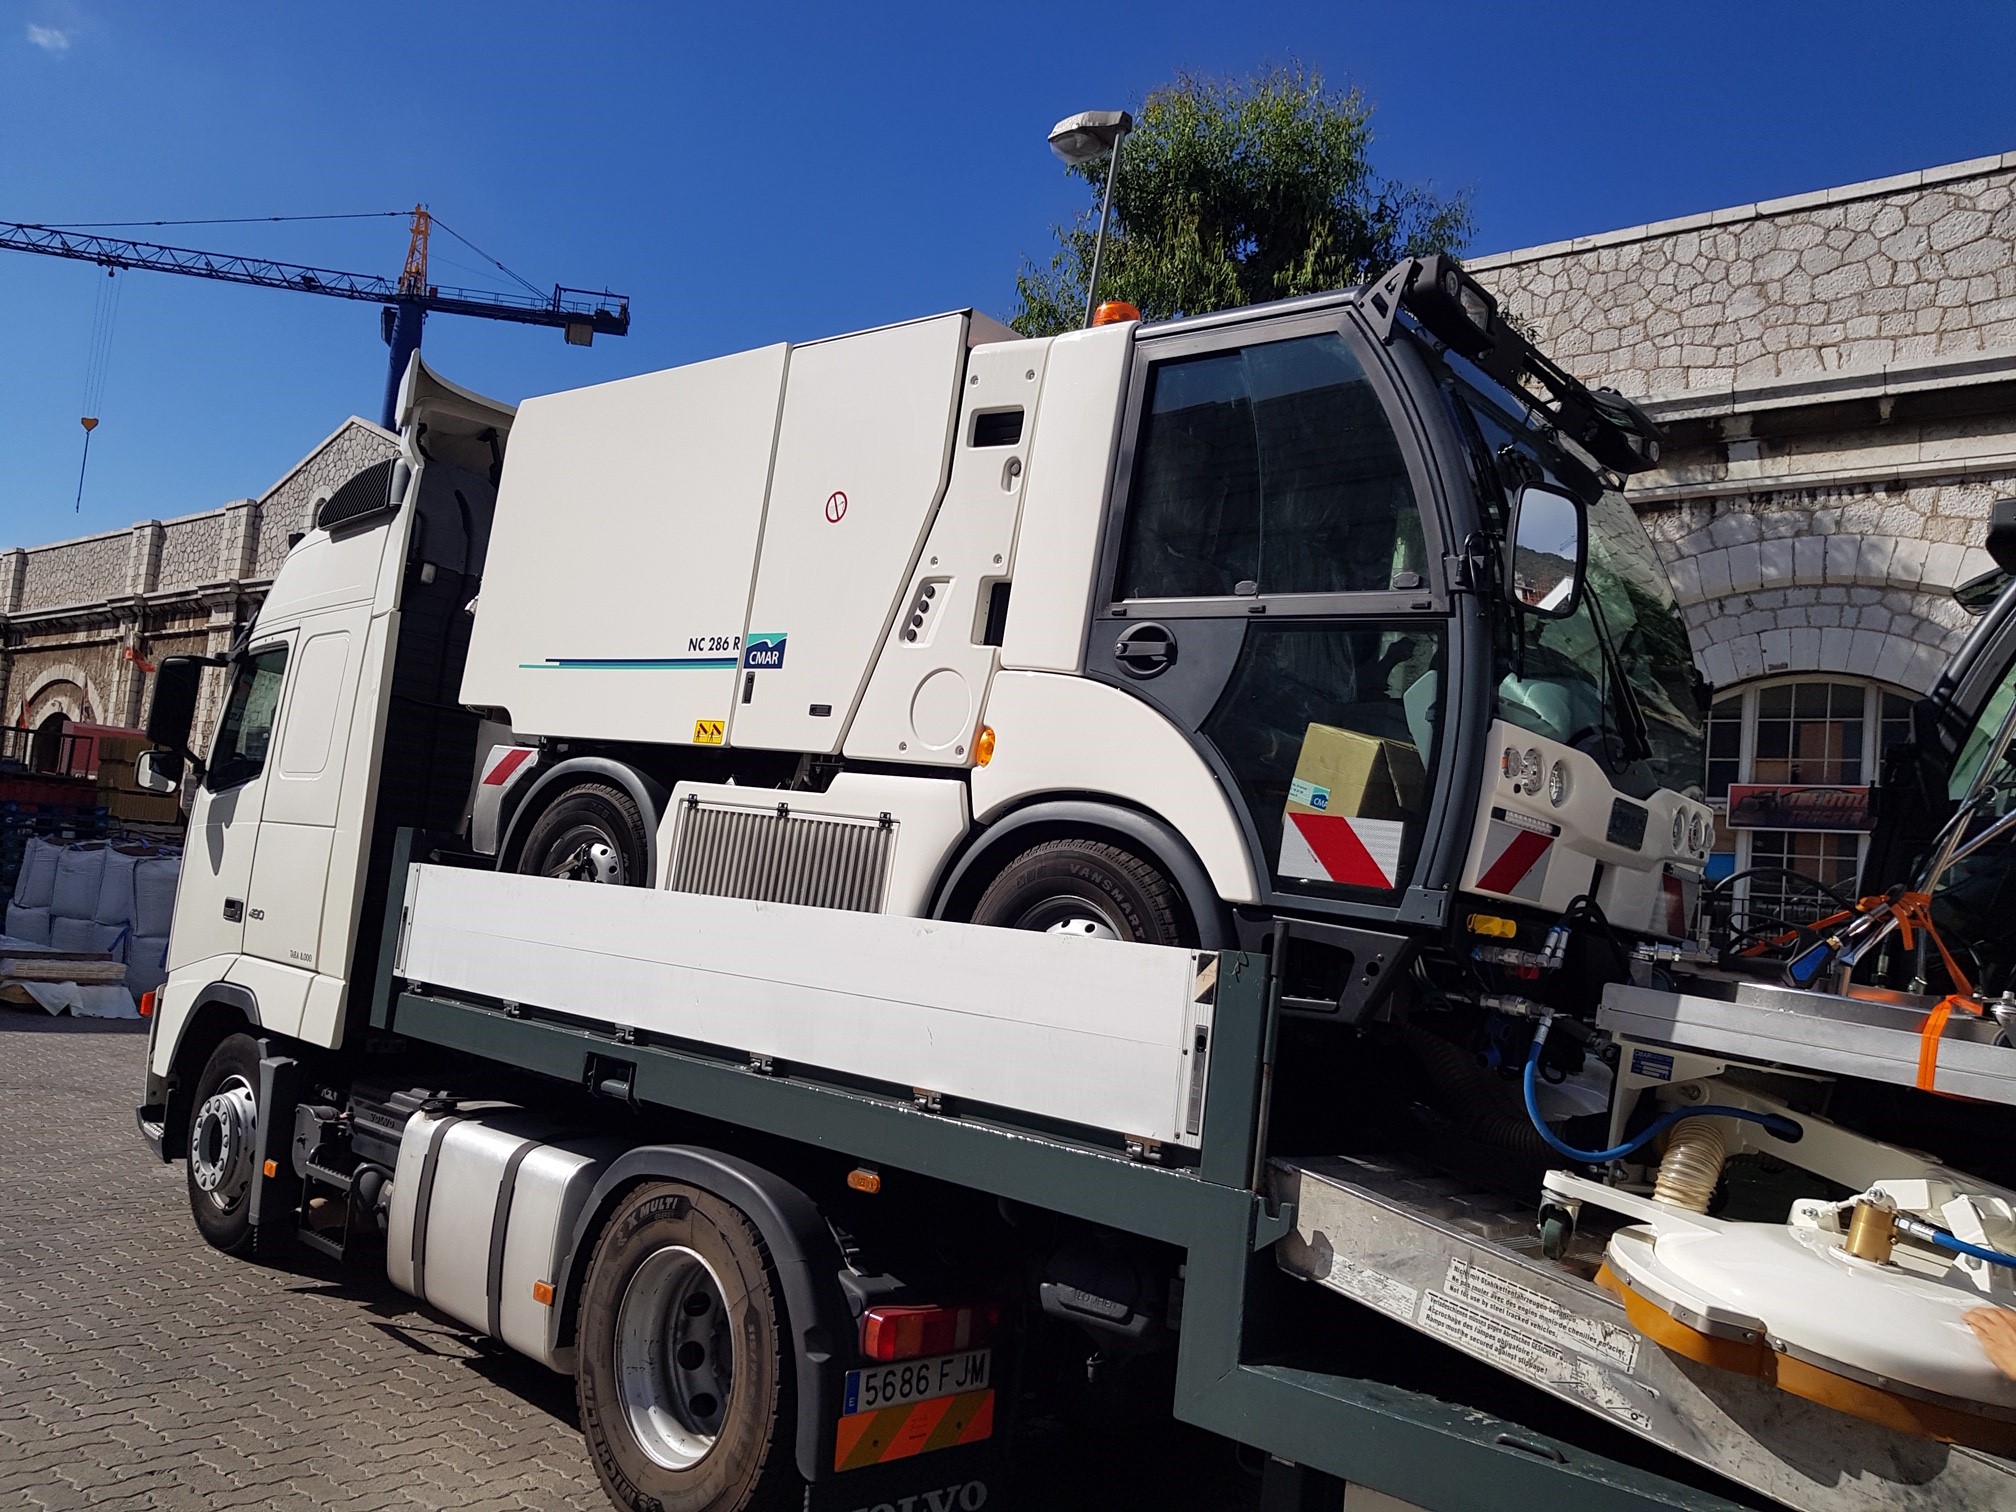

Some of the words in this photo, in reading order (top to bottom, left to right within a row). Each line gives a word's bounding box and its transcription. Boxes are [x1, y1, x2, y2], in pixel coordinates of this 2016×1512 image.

[688, 637, 706, 652] NC
[708, 636, 729, 651] 286
[733, 636, 741, 651] R
[749, 651, 779, 665] CMAR
[1069, 863, 1146, 939] VANSMART
[369, 1112, 394, 1128] VOLVO
[639, 1197, 679, 1219] MULTI
[1481, 1298, 1488, 1308] by
[1489, 1303, 1505, 1314] steel
[1505, 1310, 1529, 1325] tracked
[1505, 1298, 1516, 1308] des
[1567, 1326, 1597, 1344] chenilles
[1425, 1314, 1445, 1328] Ramps
[1469, 1334, 1493, 1350] secured
[1494, 1346, 1517, 1360] against
[1462, 1320, 1473, 1331] des
[865, 1363, 929, 1406] 5686
[938, 1353, 986, 1391] FJM
[848, 1396, 855, 1407] E
[851, 1480, 987, 1512] LVO
